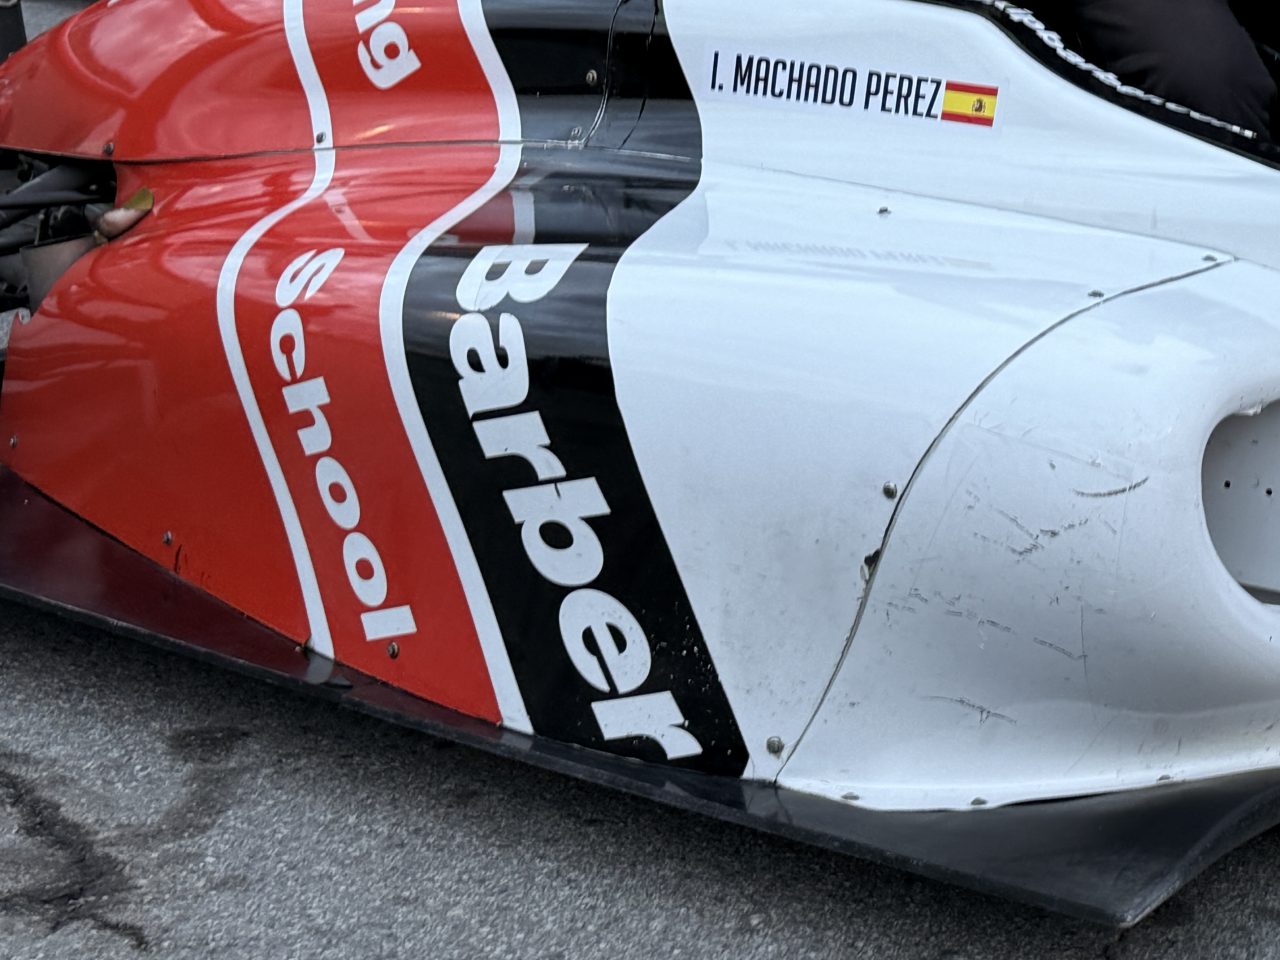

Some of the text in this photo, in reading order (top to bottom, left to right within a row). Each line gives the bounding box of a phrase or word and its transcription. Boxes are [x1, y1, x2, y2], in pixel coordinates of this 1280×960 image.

[711, 51, 943, 120] I. MACHADO PEREZ
[270, 247, 417, 641] School
[449, 242, 702, 760] Barber
